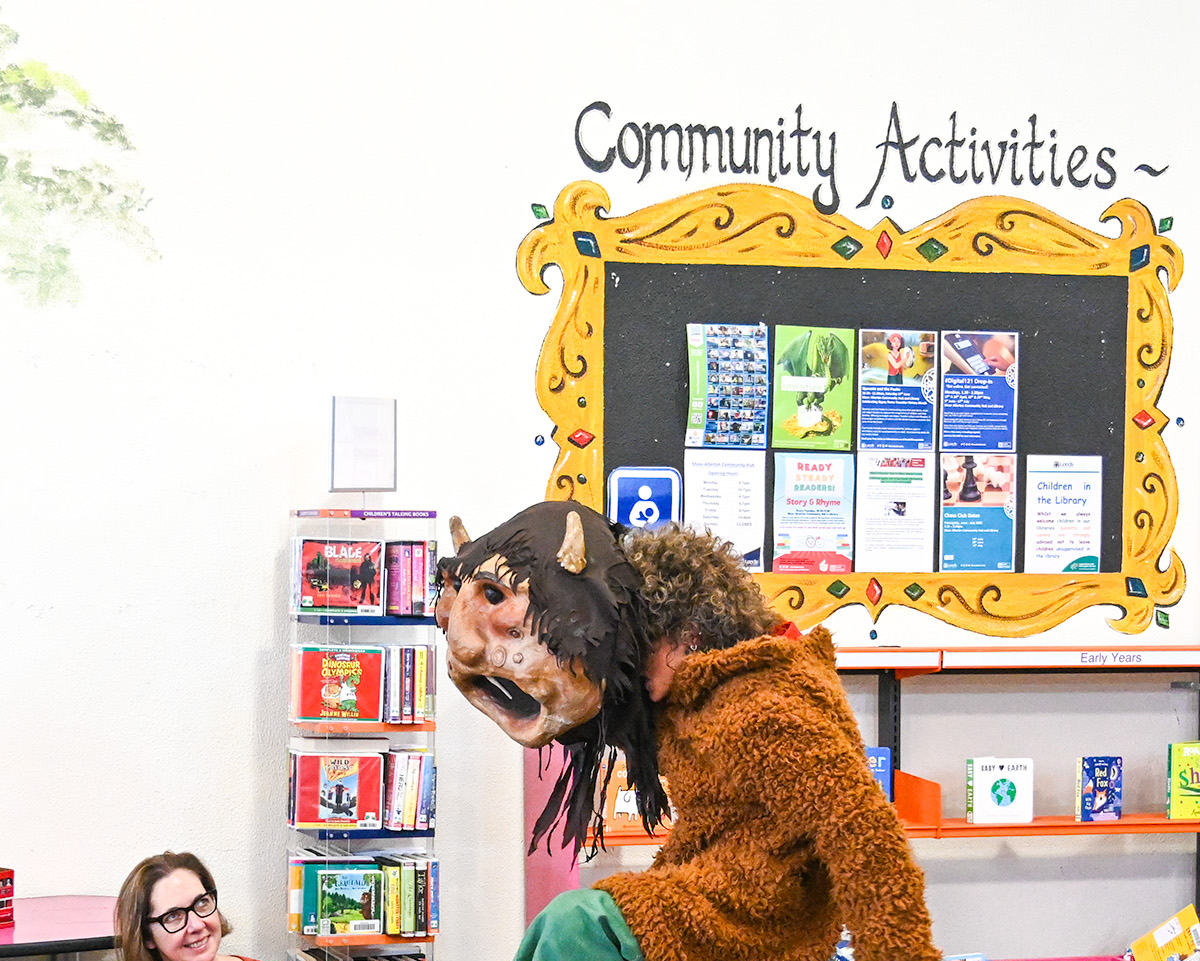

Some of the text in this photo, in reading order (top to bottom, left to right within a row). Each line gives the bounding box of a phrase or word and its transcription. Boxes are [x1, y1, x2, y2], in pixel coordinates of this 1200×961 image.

[574, 101, 1118, 214] Community Activities
[797, 462, 832, 471] READY
[796, 474, 834, 482] STEADY
[794, 484, 835, 492] READERS!
[1037, 482, 1091, 490] Children in
[786, 498, 807, 507] Story
[816, 499, 841, 507] Rhyme
[1037, 496, 1087, 507] the Library
[1080, 652, 1142, 665] Early Years
[322, 658, 360, 669] DINOSAUR
[321, 668, 362, 677] OLYMPICS
[1095, 767, 1107, 777] Red
[1096, 778, 1109, 787] Fox
